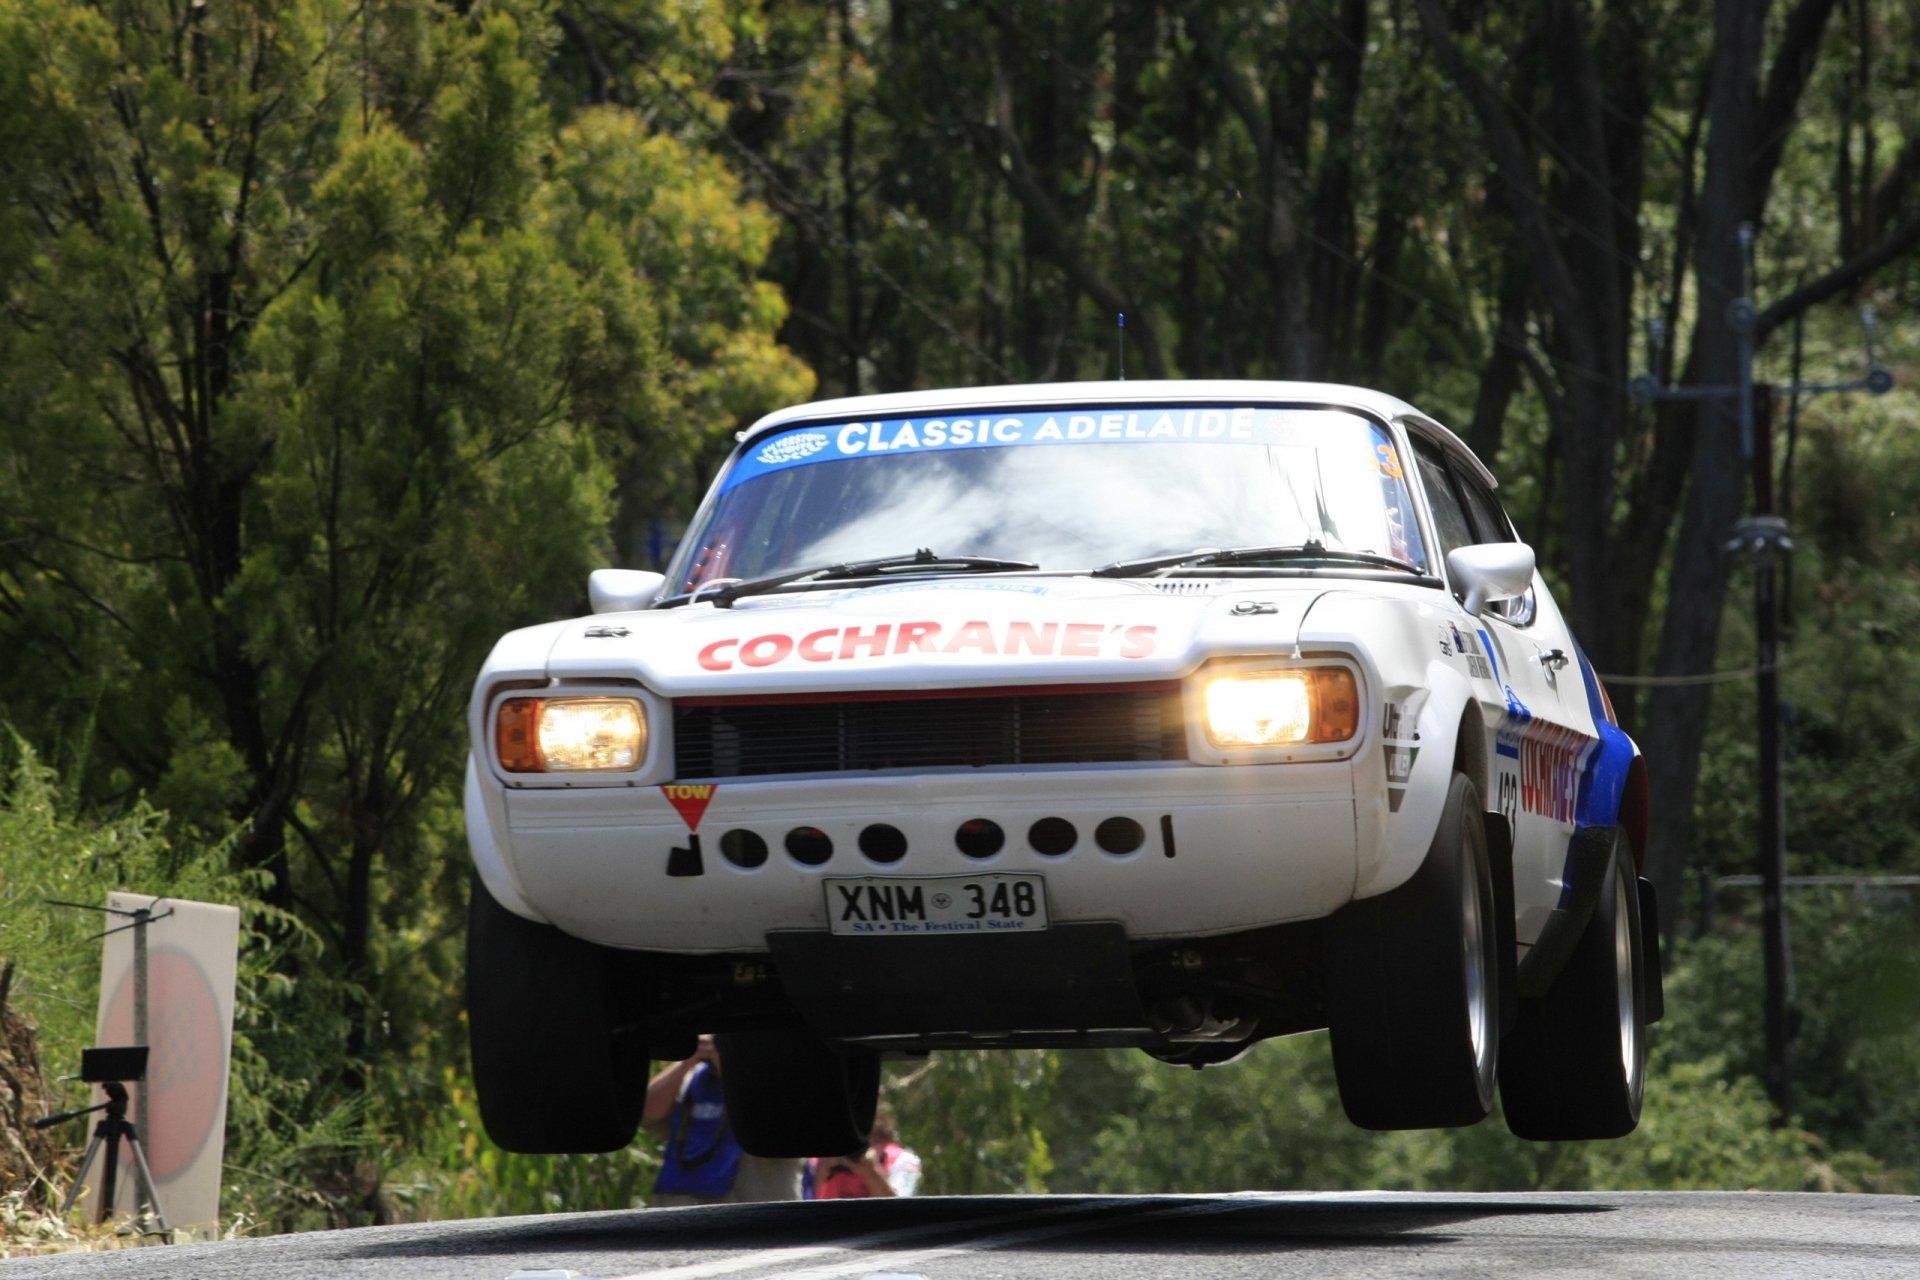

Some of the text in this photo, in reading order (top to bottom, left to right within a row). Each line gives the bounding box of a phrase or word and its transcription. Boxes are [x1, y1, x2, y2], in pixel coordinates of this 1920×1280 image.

[836, 418, 1023, 455] CLASSIC
[1033, 408, 1255, 440] ADELAIDE
[697, 621, 1157, 671] COCHRANE'S
[664, 785, 711, 799] TOW
[838, 881, 1036, 921] XNM 348
[853, 919, 1024, 932] SA The Festival State
